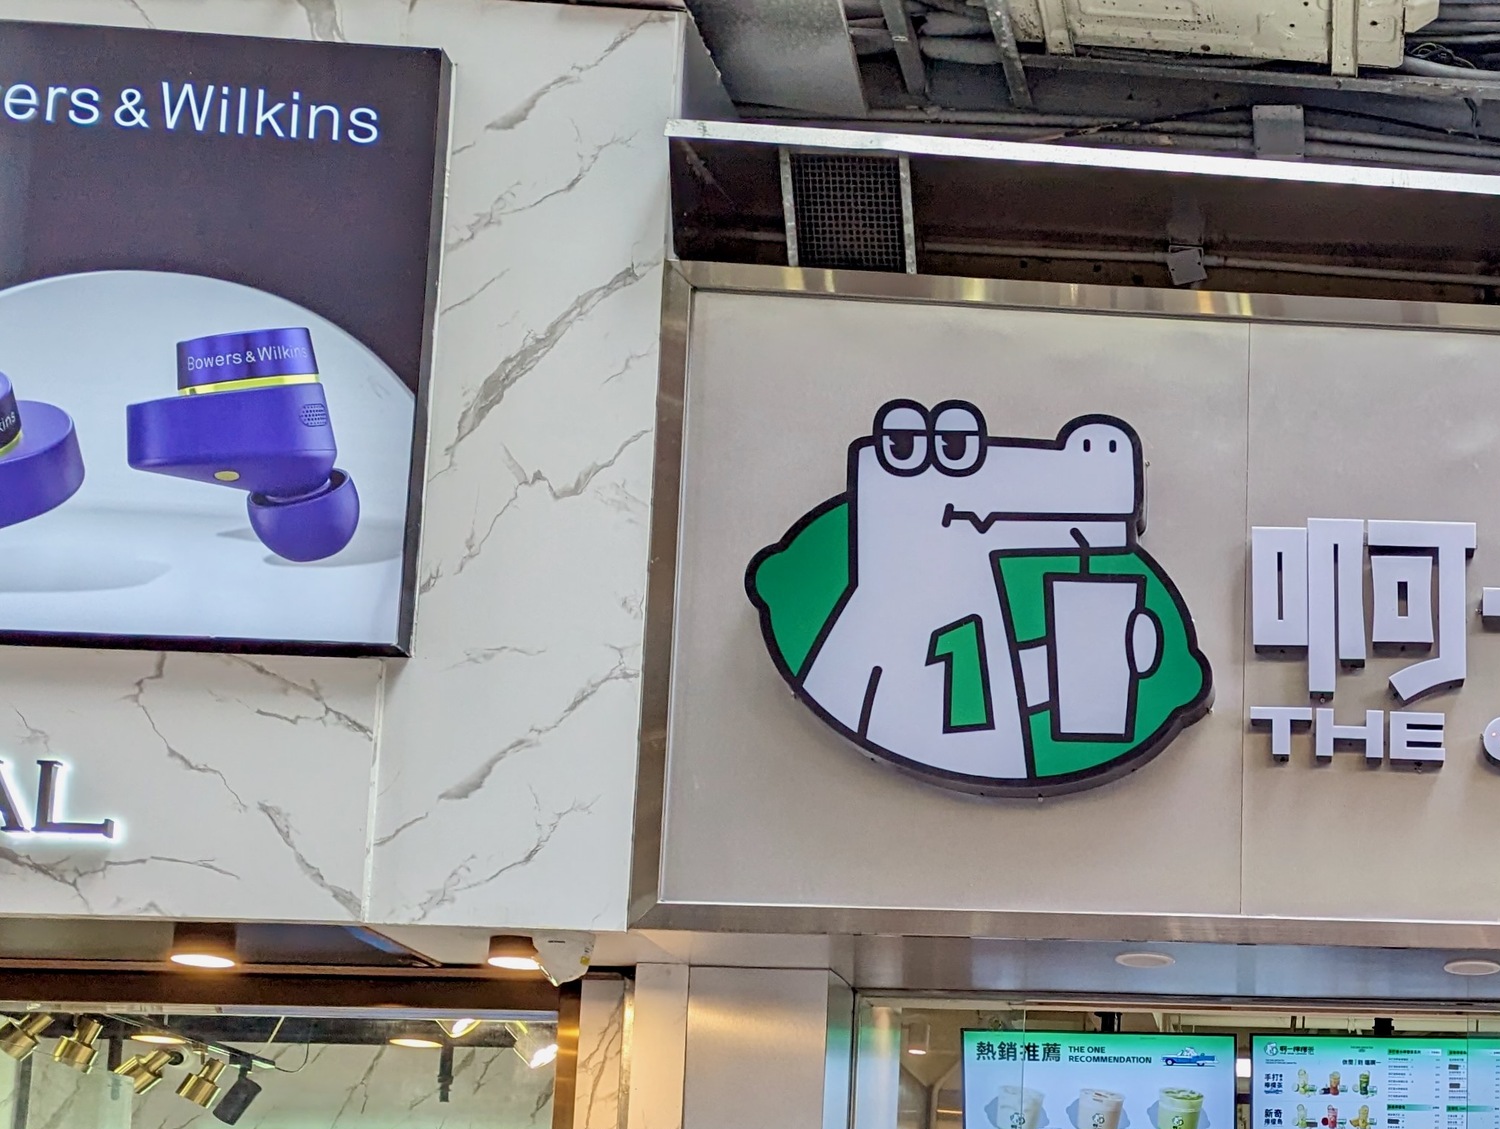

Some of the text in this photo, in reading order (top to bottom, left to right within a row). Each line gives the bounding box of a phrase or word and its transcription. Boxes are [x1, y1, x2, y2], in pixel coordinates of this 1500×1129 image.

[0, 81, 380, 144] ers & Wilkins
[187, 344, 308, 371] Bowers & Wilkins
[1250, 706, 1446, 770] THE
[976, 1041, 1061, 1062] 熱銷推薦
[1068, 1046, 1106, 1054] THE ONE
[1068, 1055, 1152, 1064] RECOMMENDATION
